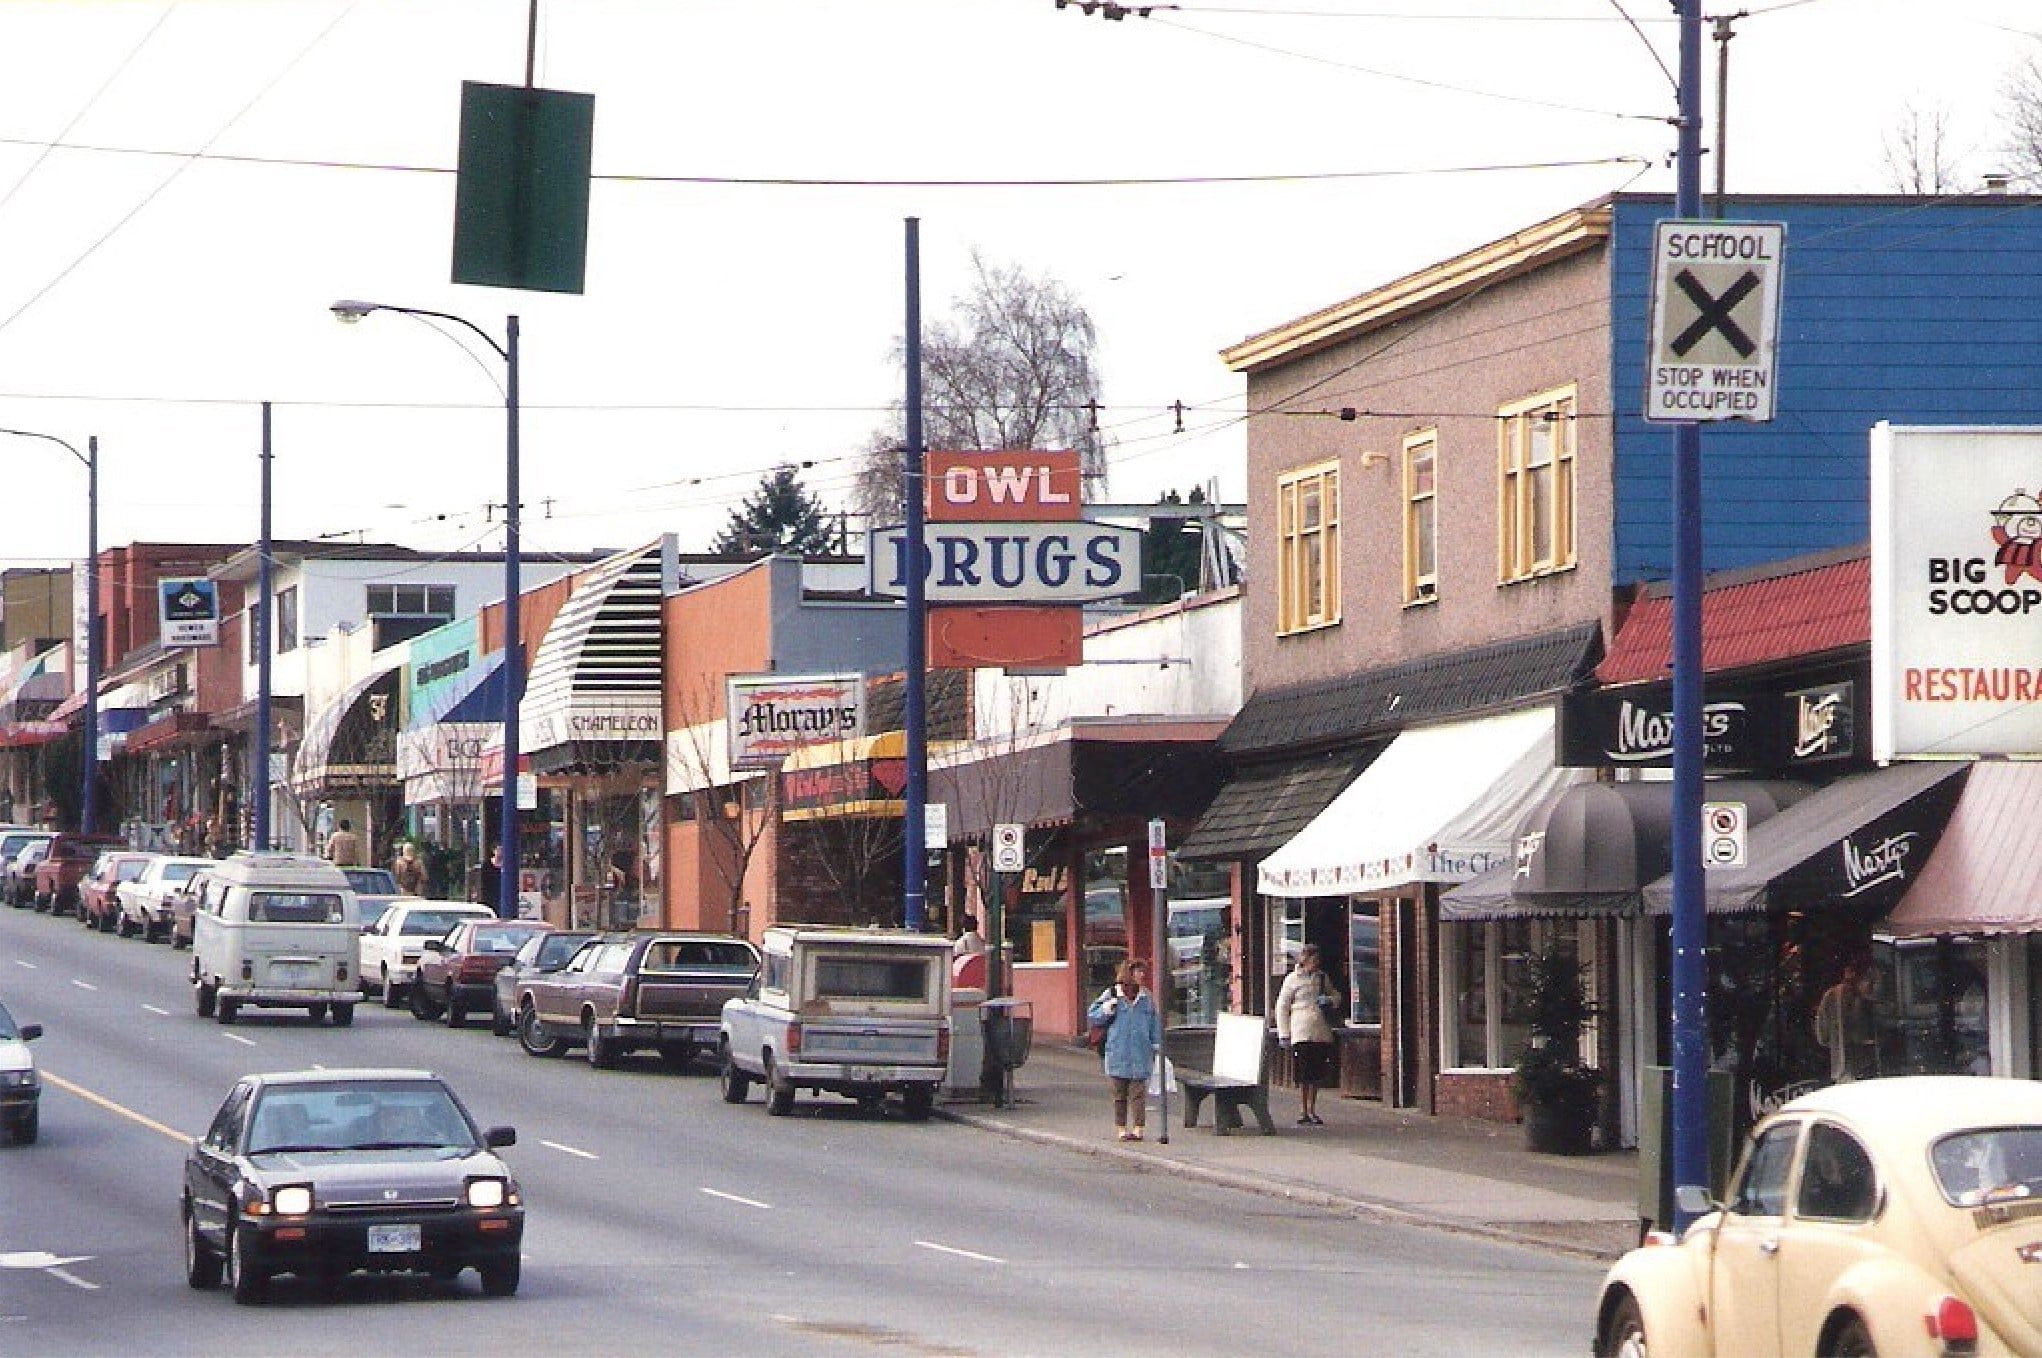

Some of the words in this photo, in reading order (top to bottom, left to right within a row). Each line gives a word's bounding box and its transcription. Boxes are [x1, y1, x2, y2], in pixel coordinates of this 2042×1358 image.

[1668, 234, 1771, 260] SCHOOL
[1657, 368, 1703, 385] STOP
[1713, 369, 1767, 388] WHEN
[1662, 391, 1758, 410] OCCUPIED
[945, 466, 1070, 503] OWL
[889, 535, 1122, 588] DRUGS
[1929, 558, 1986, 583] BIG
[1929, 590, 2041, 614] SCOOP
[572, 715, 657, 731] CHAMELEON
